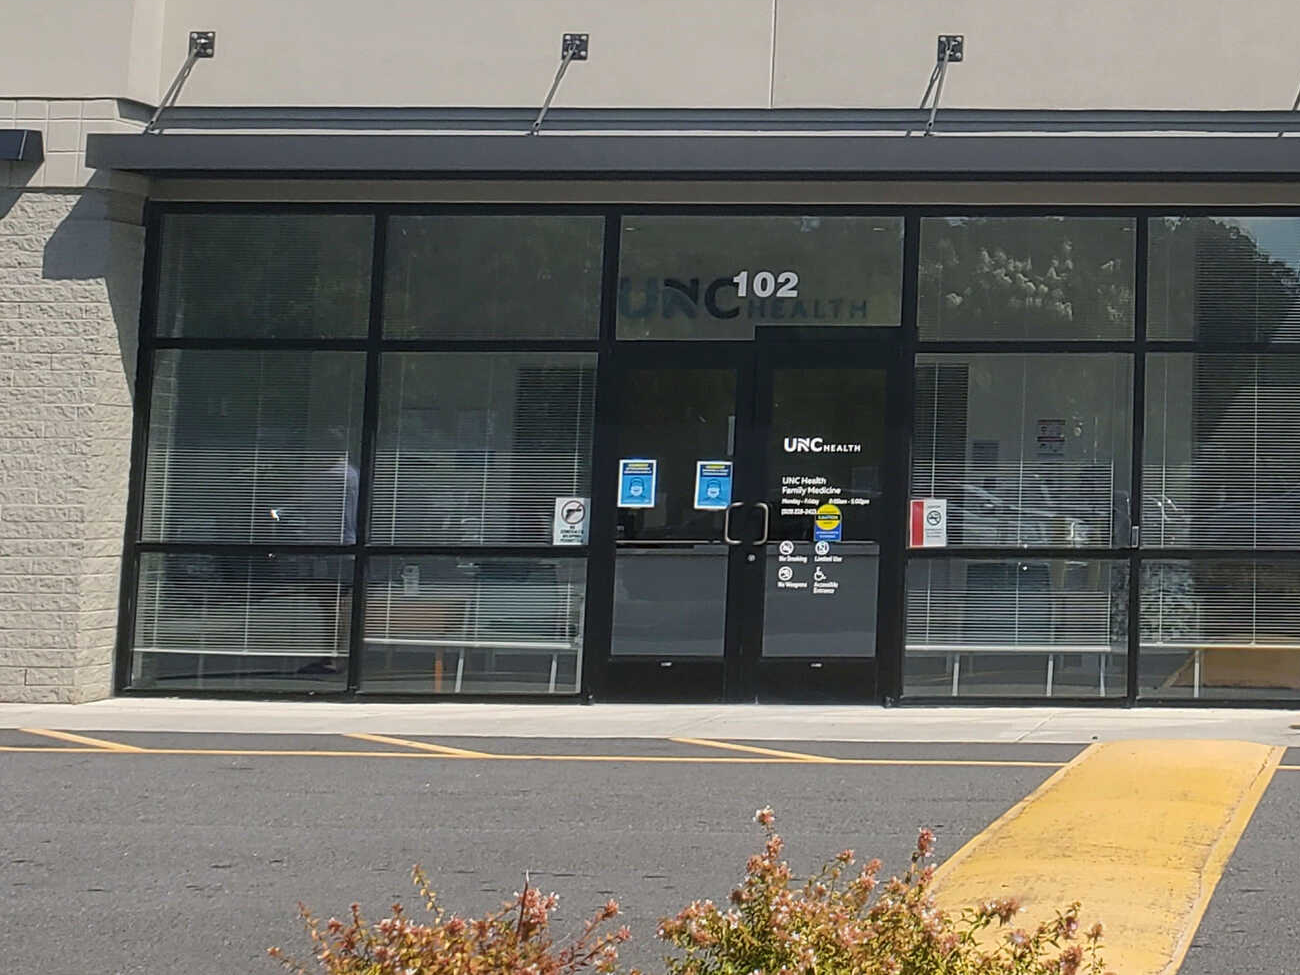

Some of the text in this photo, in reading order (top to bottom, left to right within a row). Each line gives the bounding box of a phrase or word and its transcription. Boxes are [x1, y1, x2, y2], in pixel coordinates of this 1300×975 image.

[733, 271, 799, 298] 102
[619, 277, 868, 320] UNC HEALTH
[784, 437, 861, 453] UNC HEALTH
[782, 476, 827, 485] UNC Health
[782, 486, 842, 496] Family Medicine
